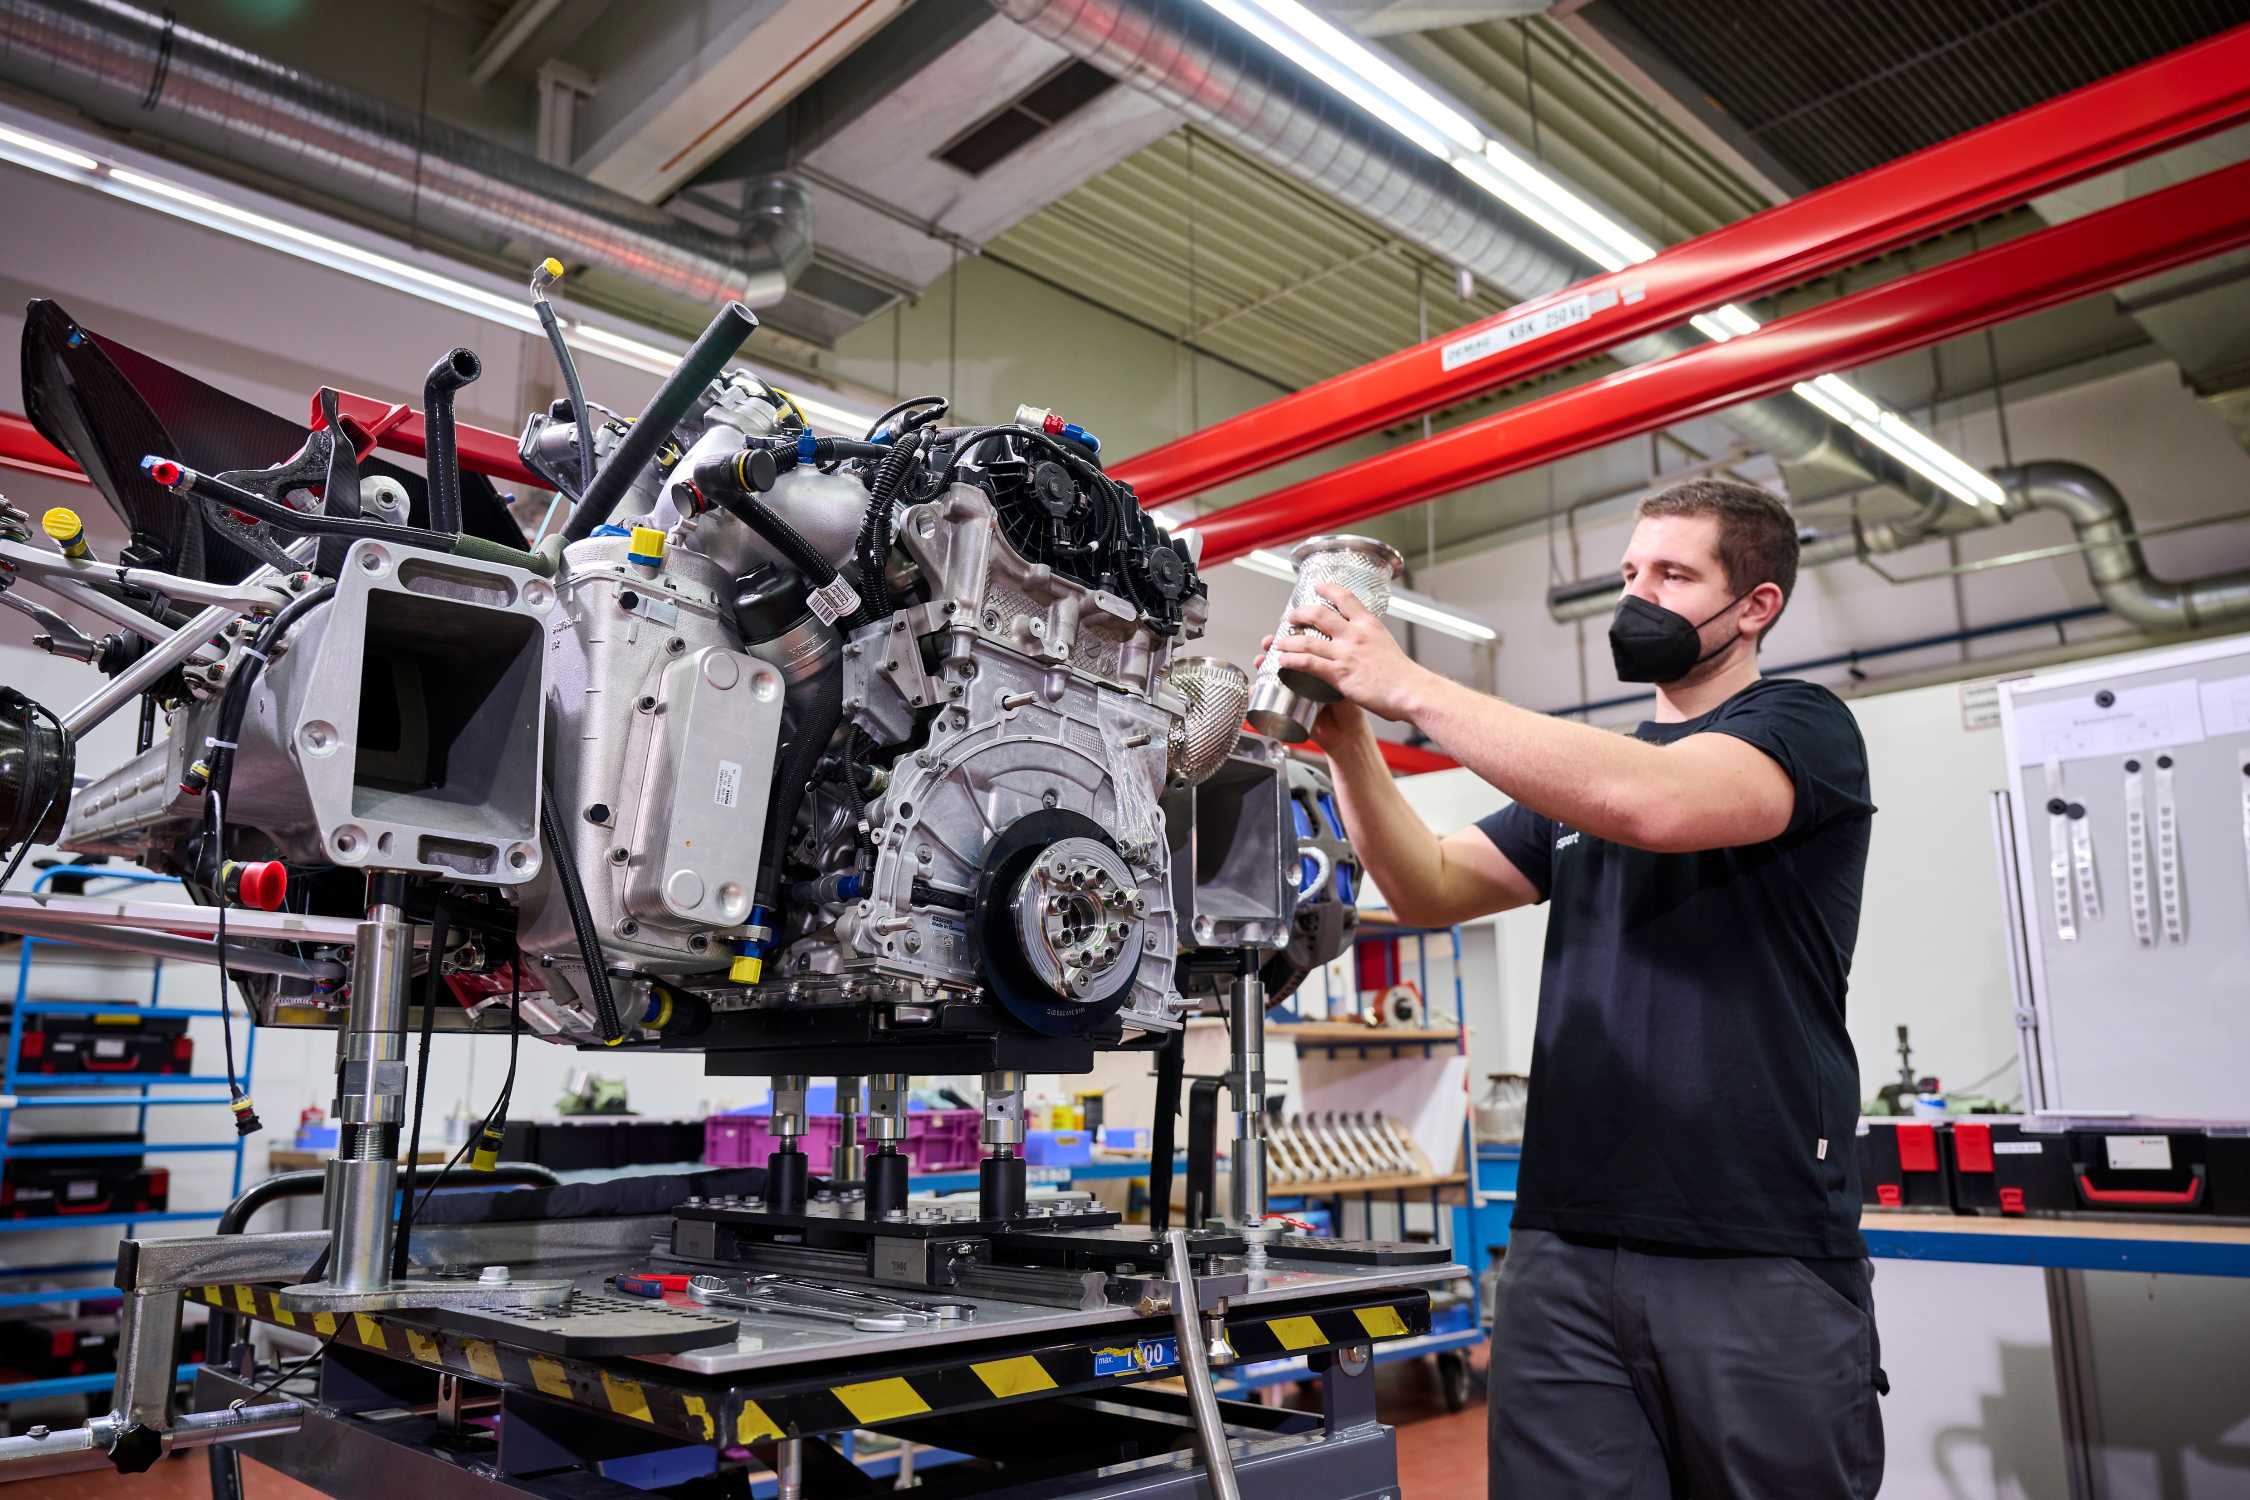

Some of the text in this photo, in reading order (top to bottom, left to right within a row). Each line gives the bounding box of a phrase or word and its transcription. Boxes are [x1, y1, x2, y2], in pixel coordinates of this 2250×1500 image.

[1508, 319, 1535, 340] KBK
[1546, 308, 1567, 328] 250
[1571, 303, 1585, 321] kg
[1098, 1356, 1114, 1365] max.
